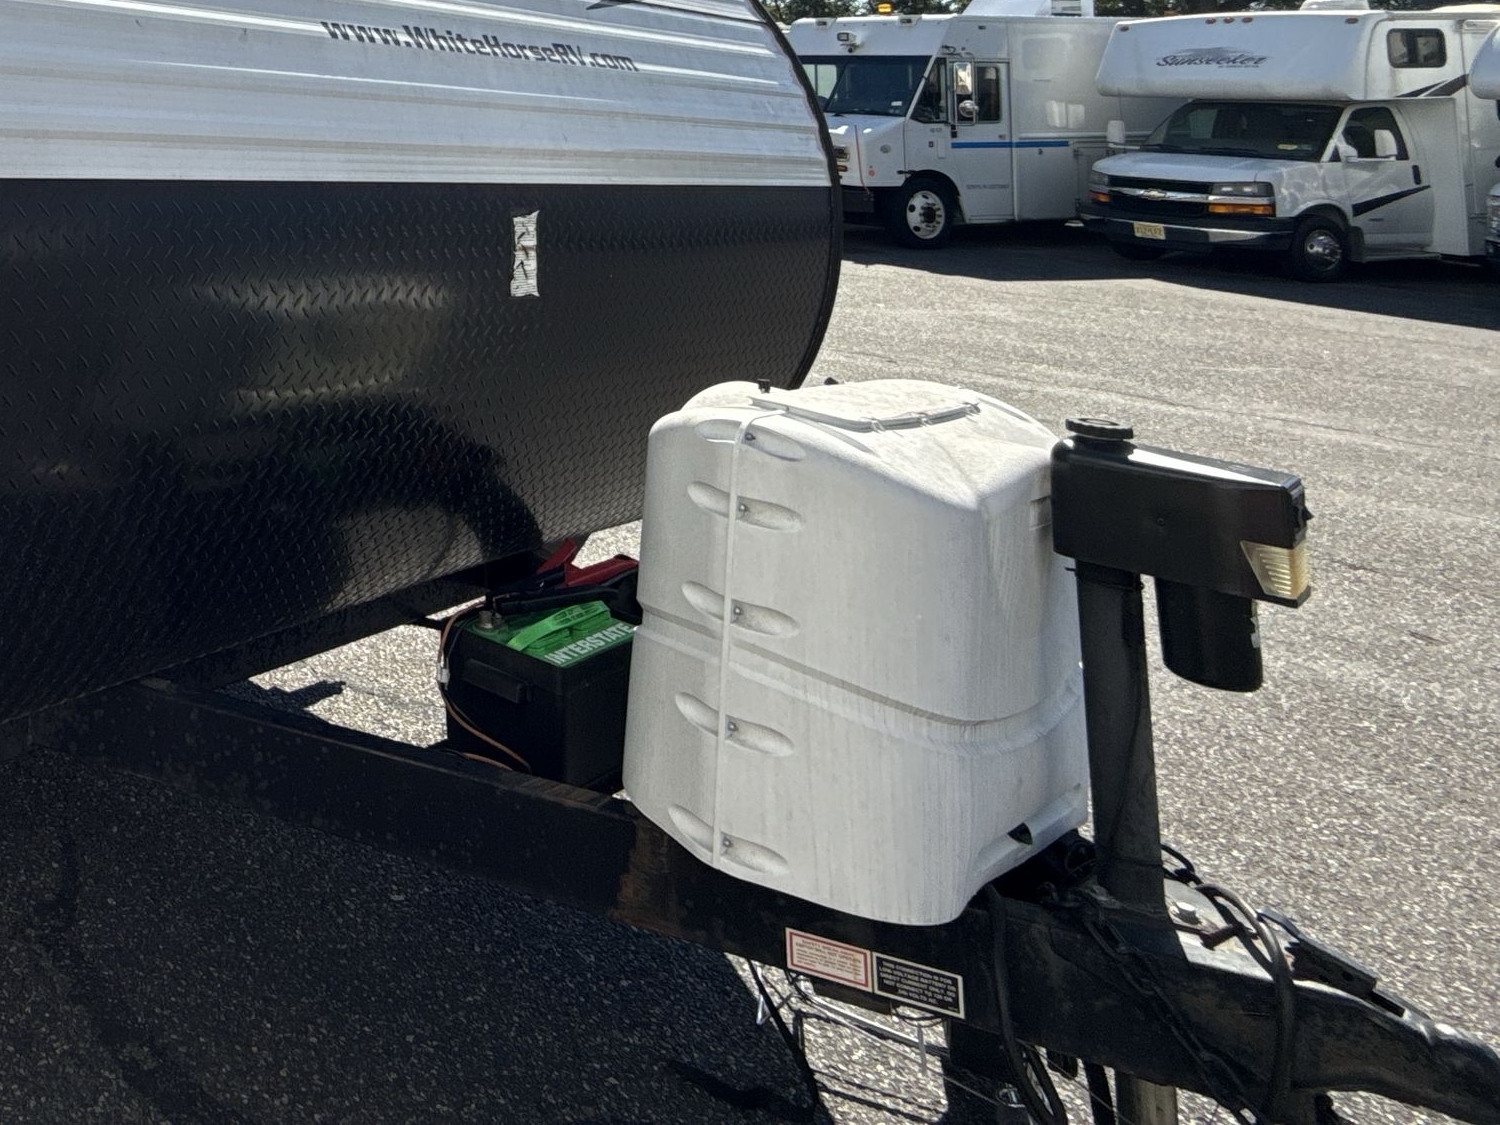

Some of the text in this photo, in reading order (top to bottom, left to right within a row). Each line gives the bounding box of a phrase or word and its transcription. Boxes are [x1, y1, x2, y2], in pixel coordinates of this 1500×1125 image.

[320, 21, 639, 72] www.WhiteHorseRV.com
[1156, 54, 1267, 66] Sunseeker
[544, 622, 635, 665] INTERSTATE
